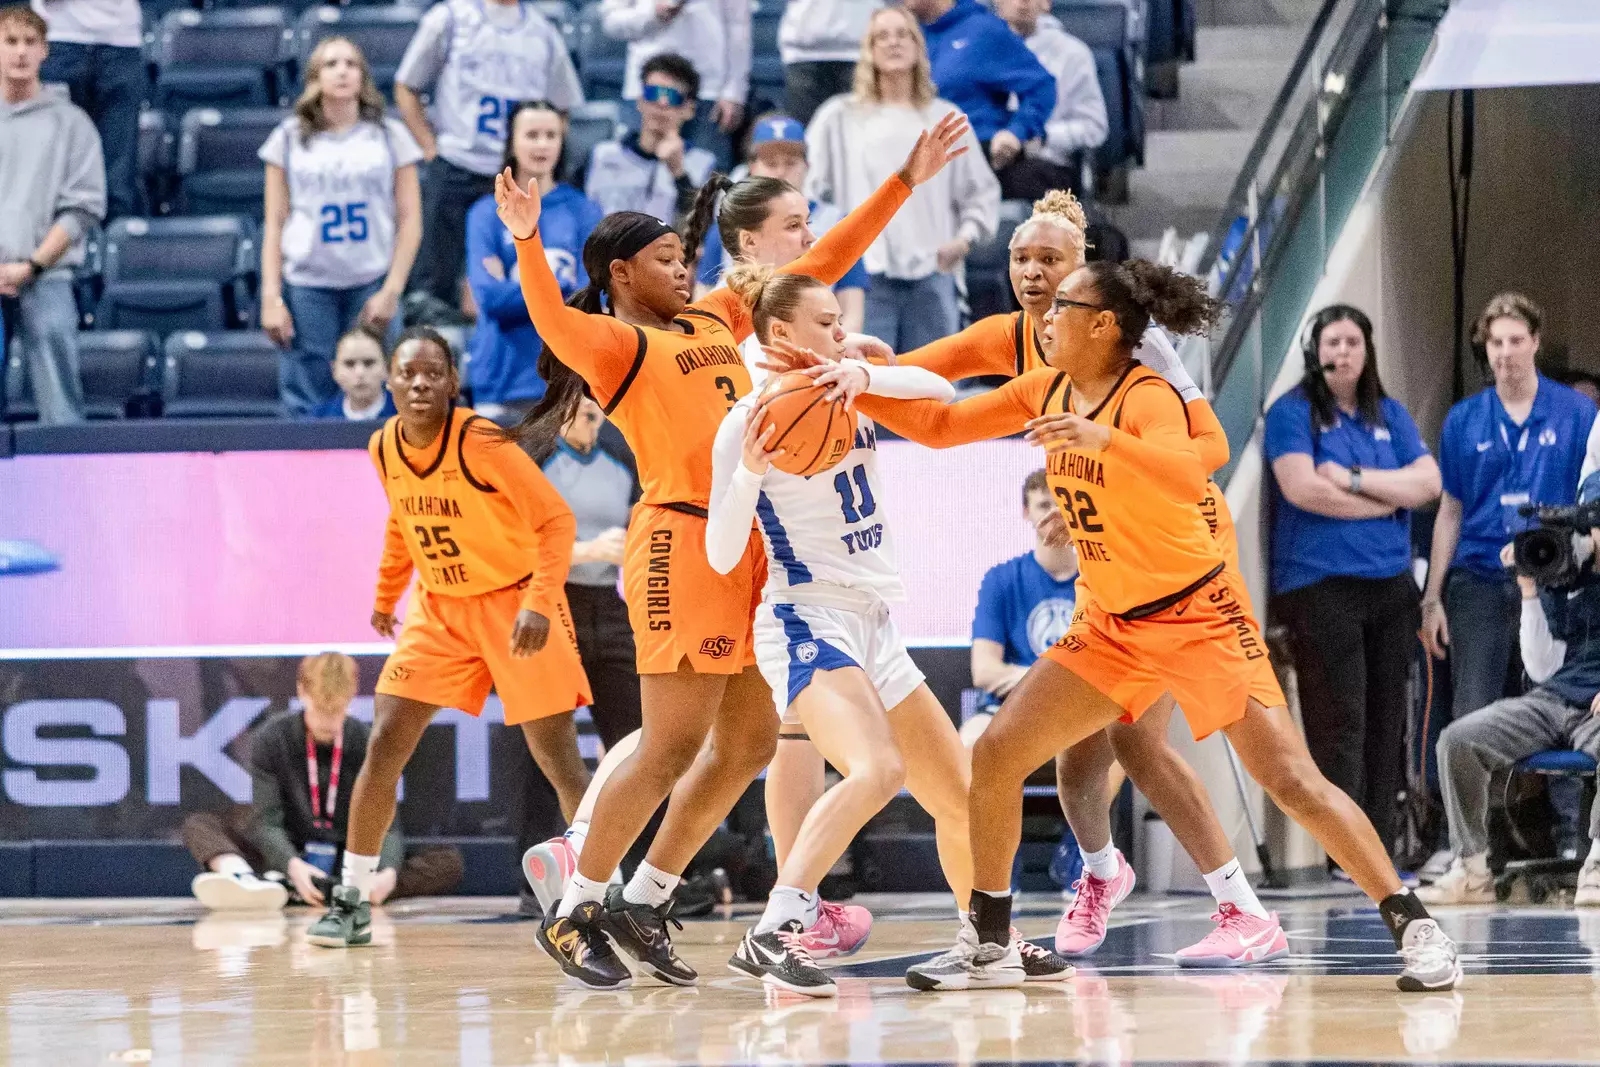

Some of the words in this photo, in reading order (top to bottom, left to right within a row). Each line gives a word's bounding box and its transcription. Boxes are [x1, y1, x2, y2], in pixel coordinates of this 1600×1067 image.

[321, 203, 367, 243] 25
[675, 345, 745, 375] OKLAHOMA
[715, 376, 739, 412] 3
[834, 464, 876, 524] 11
[1054, 487, 1104, 532] 32
[414, 525, 461, 560] 25
[1077, 540, 1111, 562] TATE
[647, 529, 672, 632] COWGIRLS
[700, 636, 735, 659] OSU
